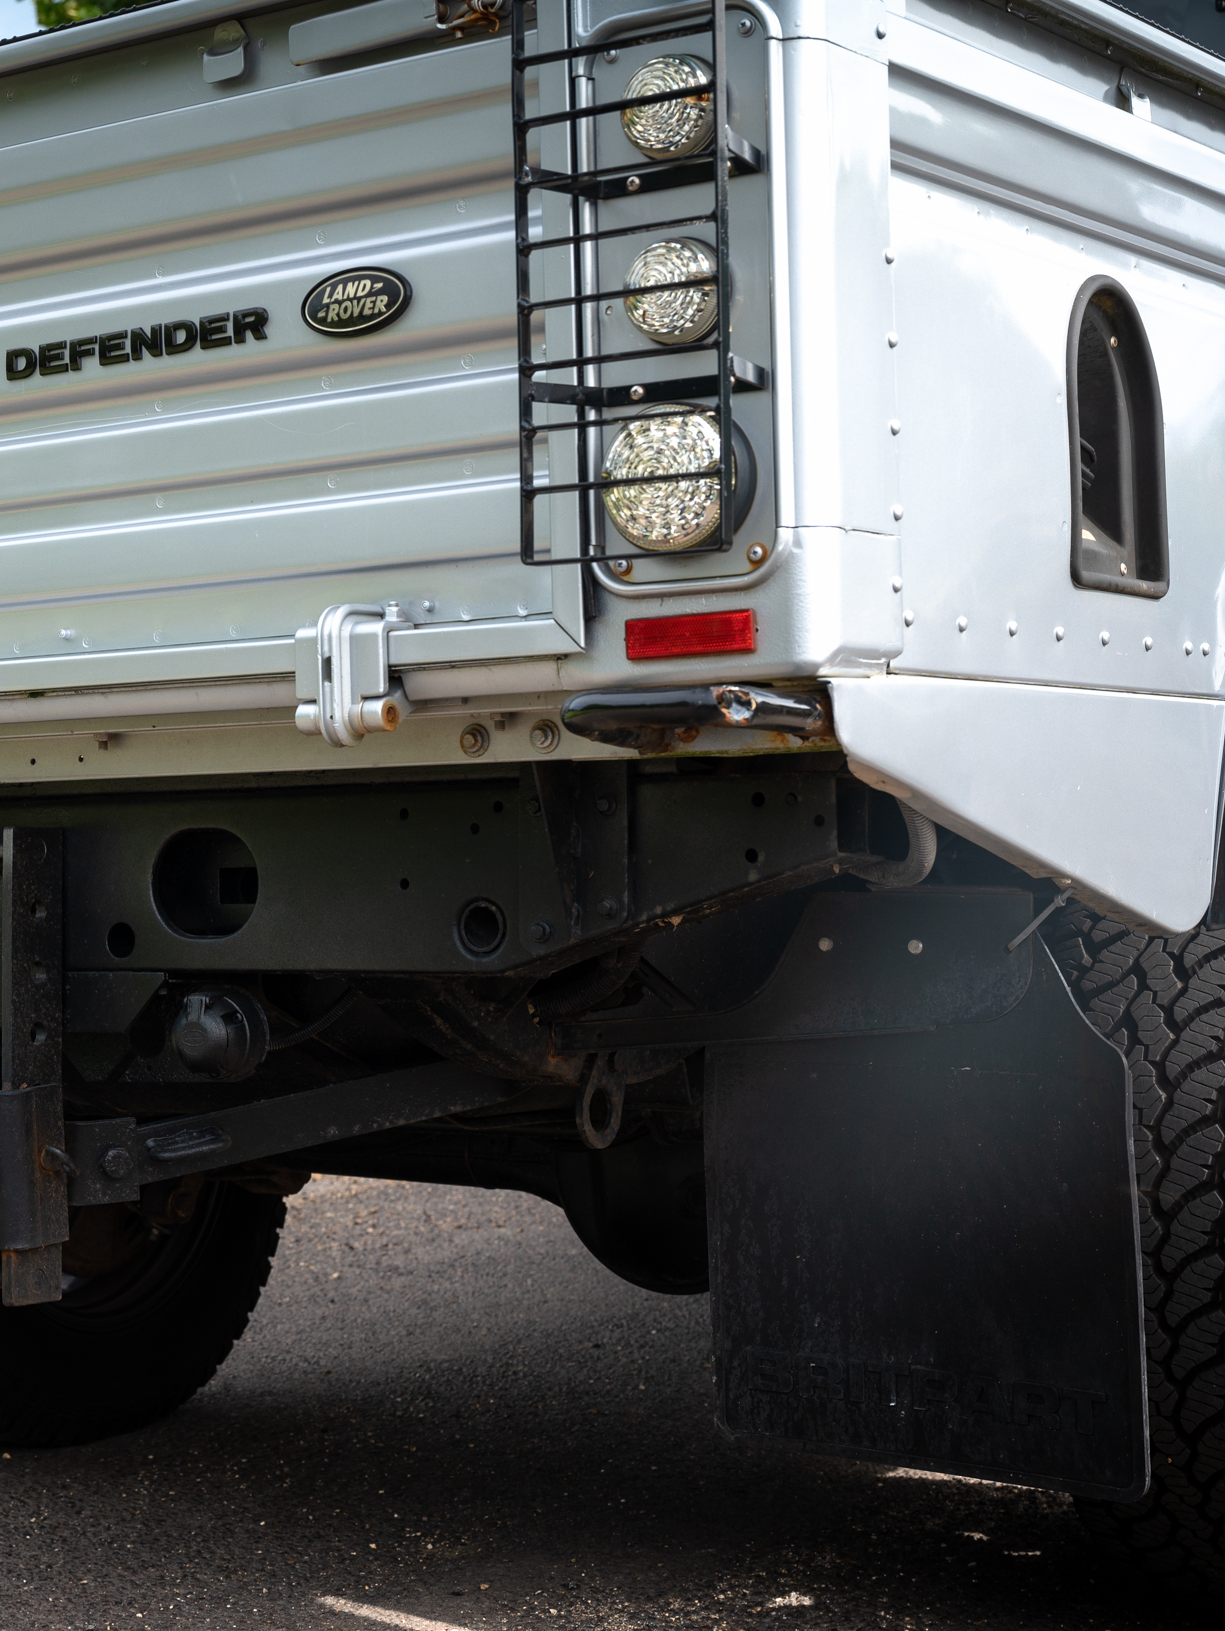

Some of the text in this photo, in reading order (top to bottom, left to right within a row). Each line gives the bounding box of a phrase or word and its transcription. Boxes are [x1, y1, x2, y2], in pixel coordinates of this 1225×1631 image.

[322, 279, 372, 304] LAND
[326, 295, 388, 323] ROVER
[5, 307, 270, 382] DEFENDER
[745, 1346, 1108, 1436] BRITPART
